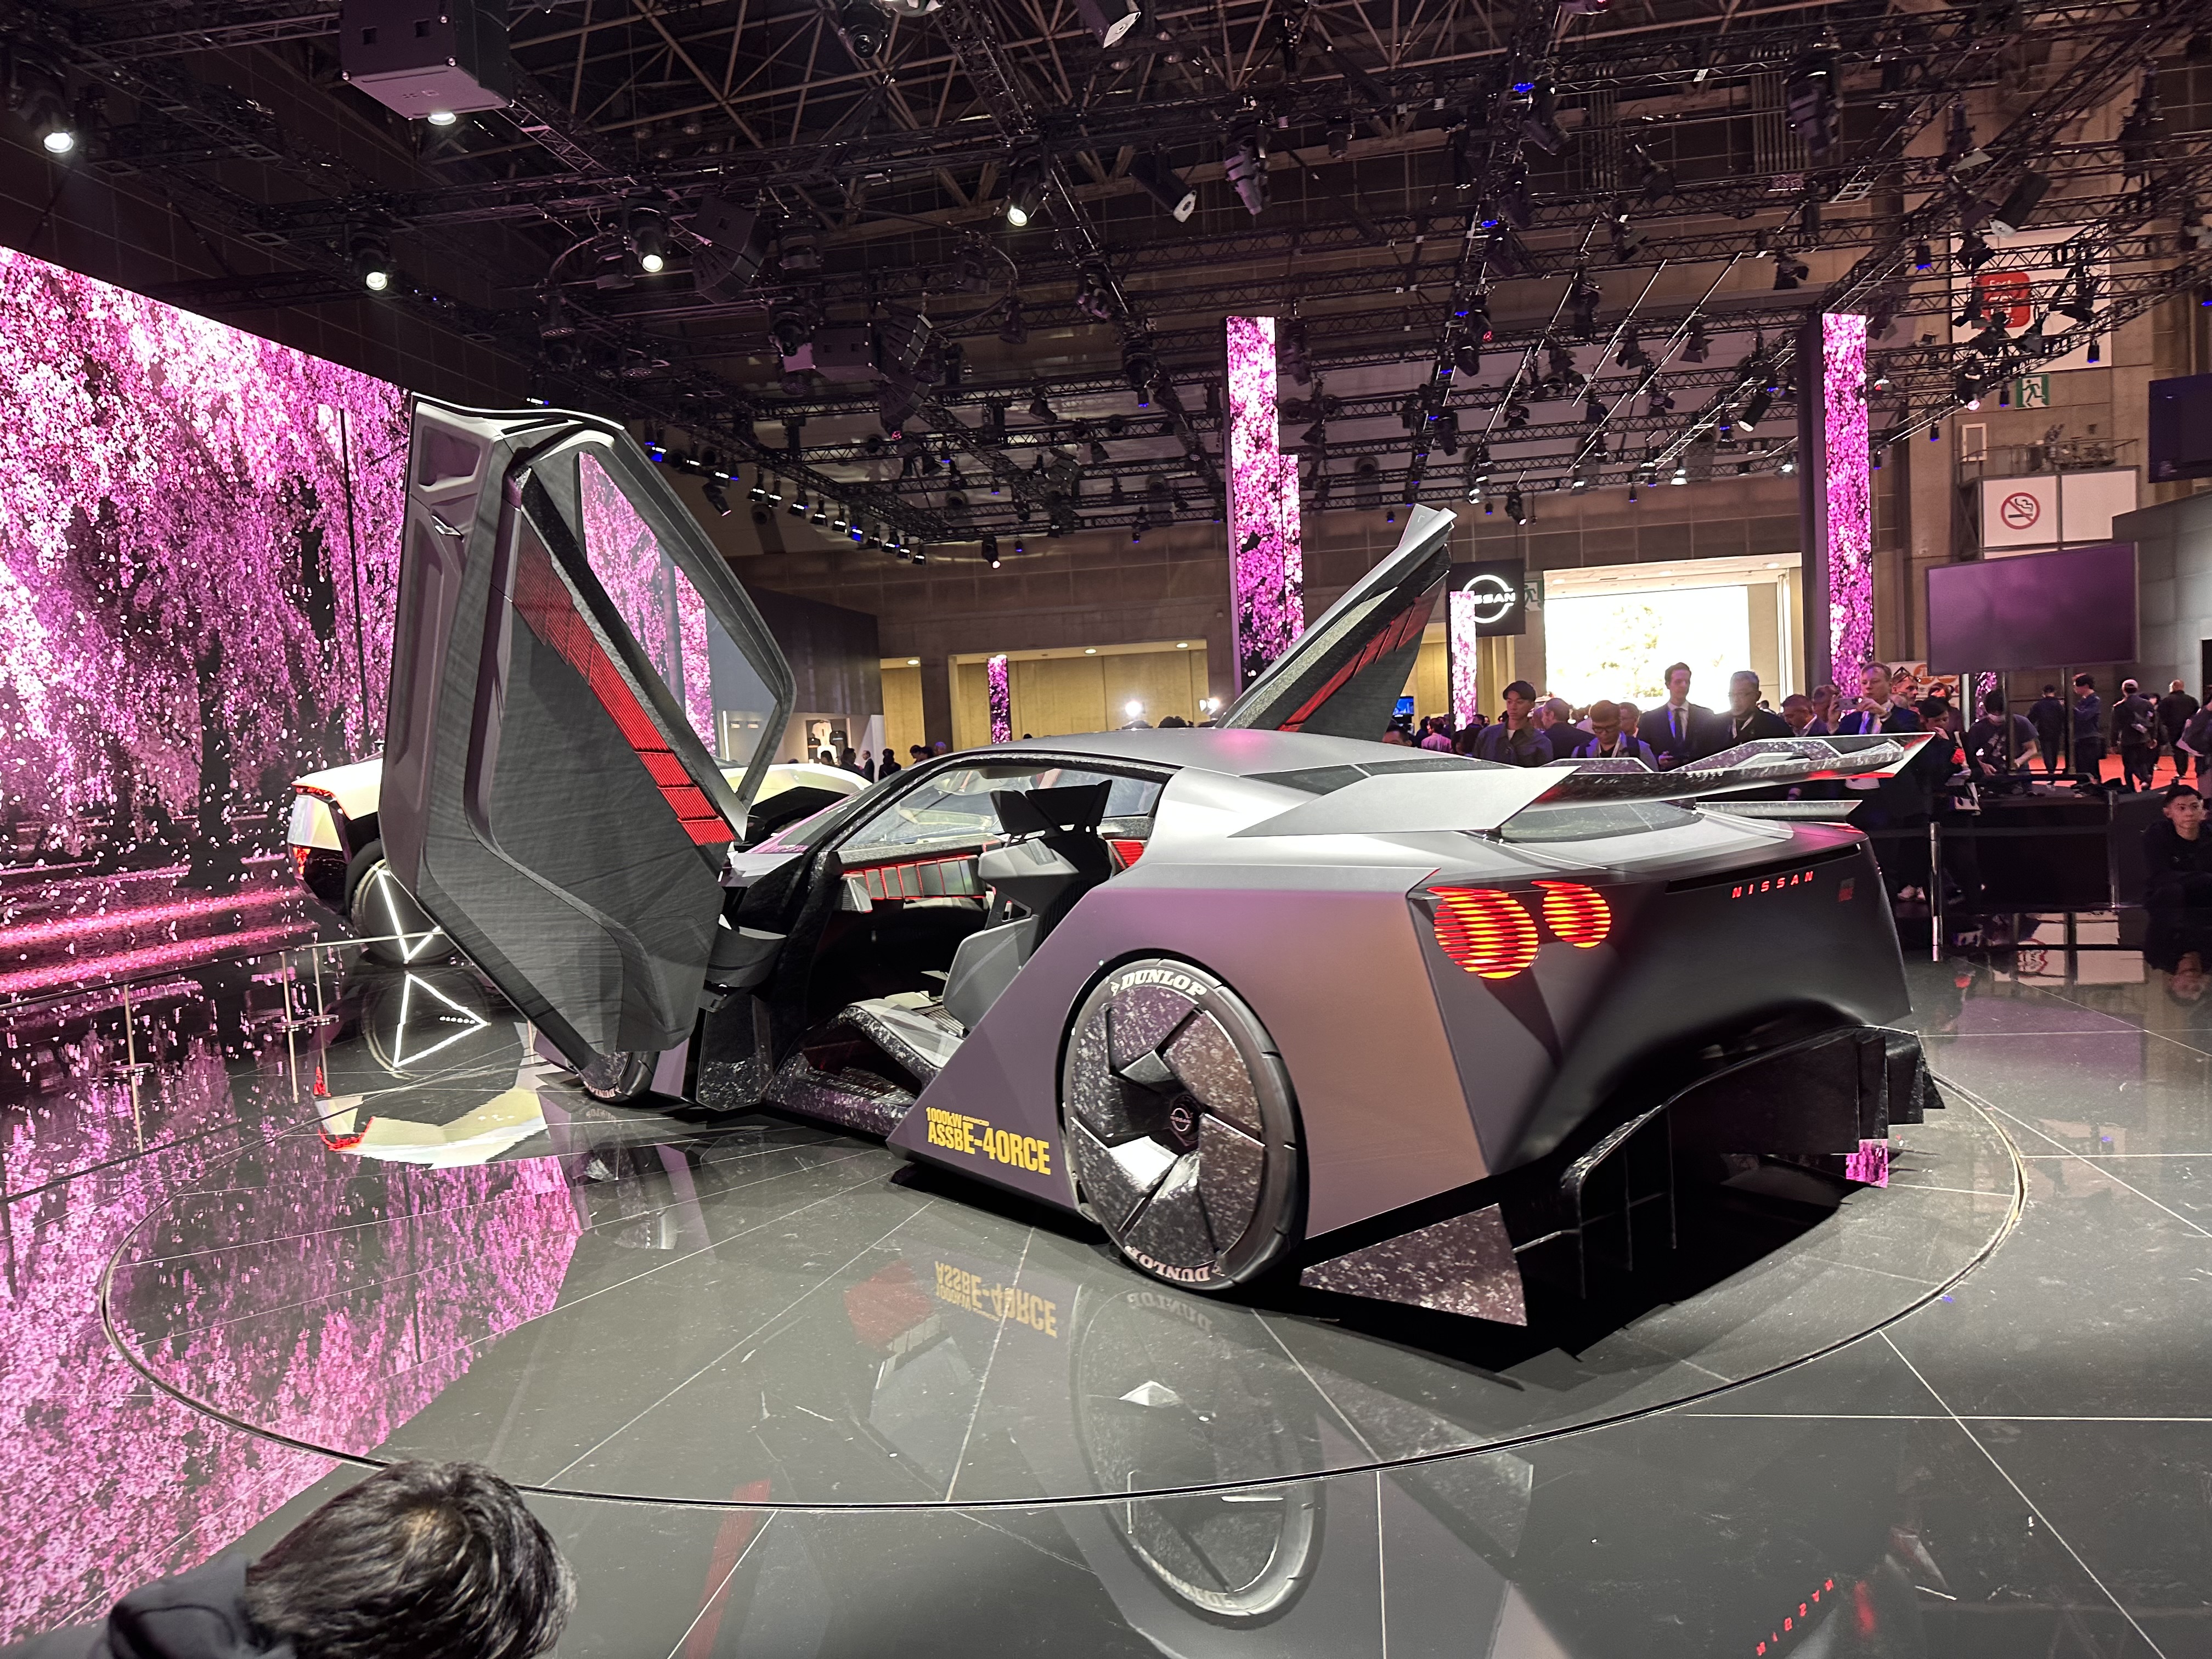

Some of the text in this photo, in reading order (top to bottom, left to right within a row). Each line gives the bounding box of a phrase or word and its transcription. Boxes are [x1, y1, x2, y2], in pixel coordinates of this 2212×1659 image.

[1731, 871, 1814, 899] NISSAN
[1120, 969, 1207, 996] DUNLOP
[926, 1107, 962, 1128] 1000kW
[928, 1121, 963, 1151] ASSB
